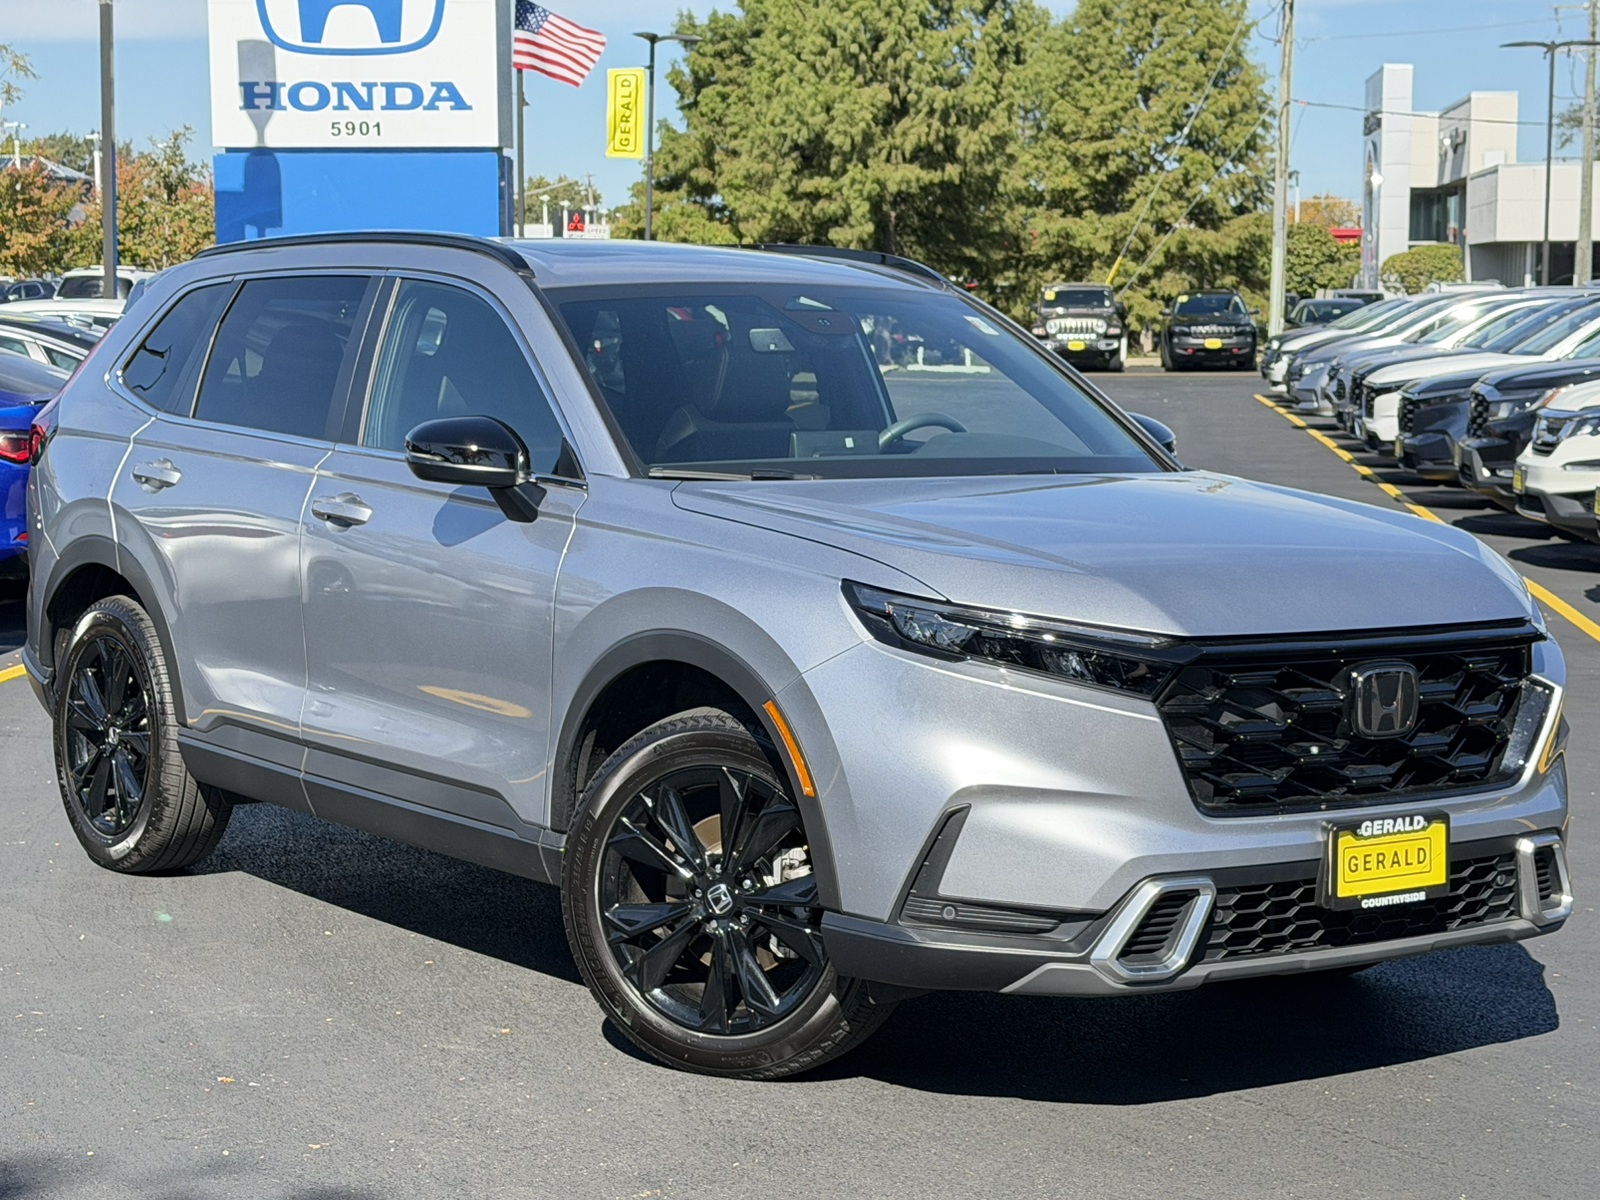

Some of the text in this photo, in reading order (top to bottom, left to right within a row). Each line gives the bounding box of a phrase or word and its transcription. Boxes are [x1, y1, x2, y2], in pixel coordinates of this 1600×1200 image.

[239, 81, 472, 111] HONDA
[620, 79, 632, 147] GERALD
[331, 121, 382, 136] 5901
[1361, 816, 1425, 836] GERALD
[1348, 847, 1427, 873] GERALD
[1361, 891, 1426, 908] COUNTRYSIDE
